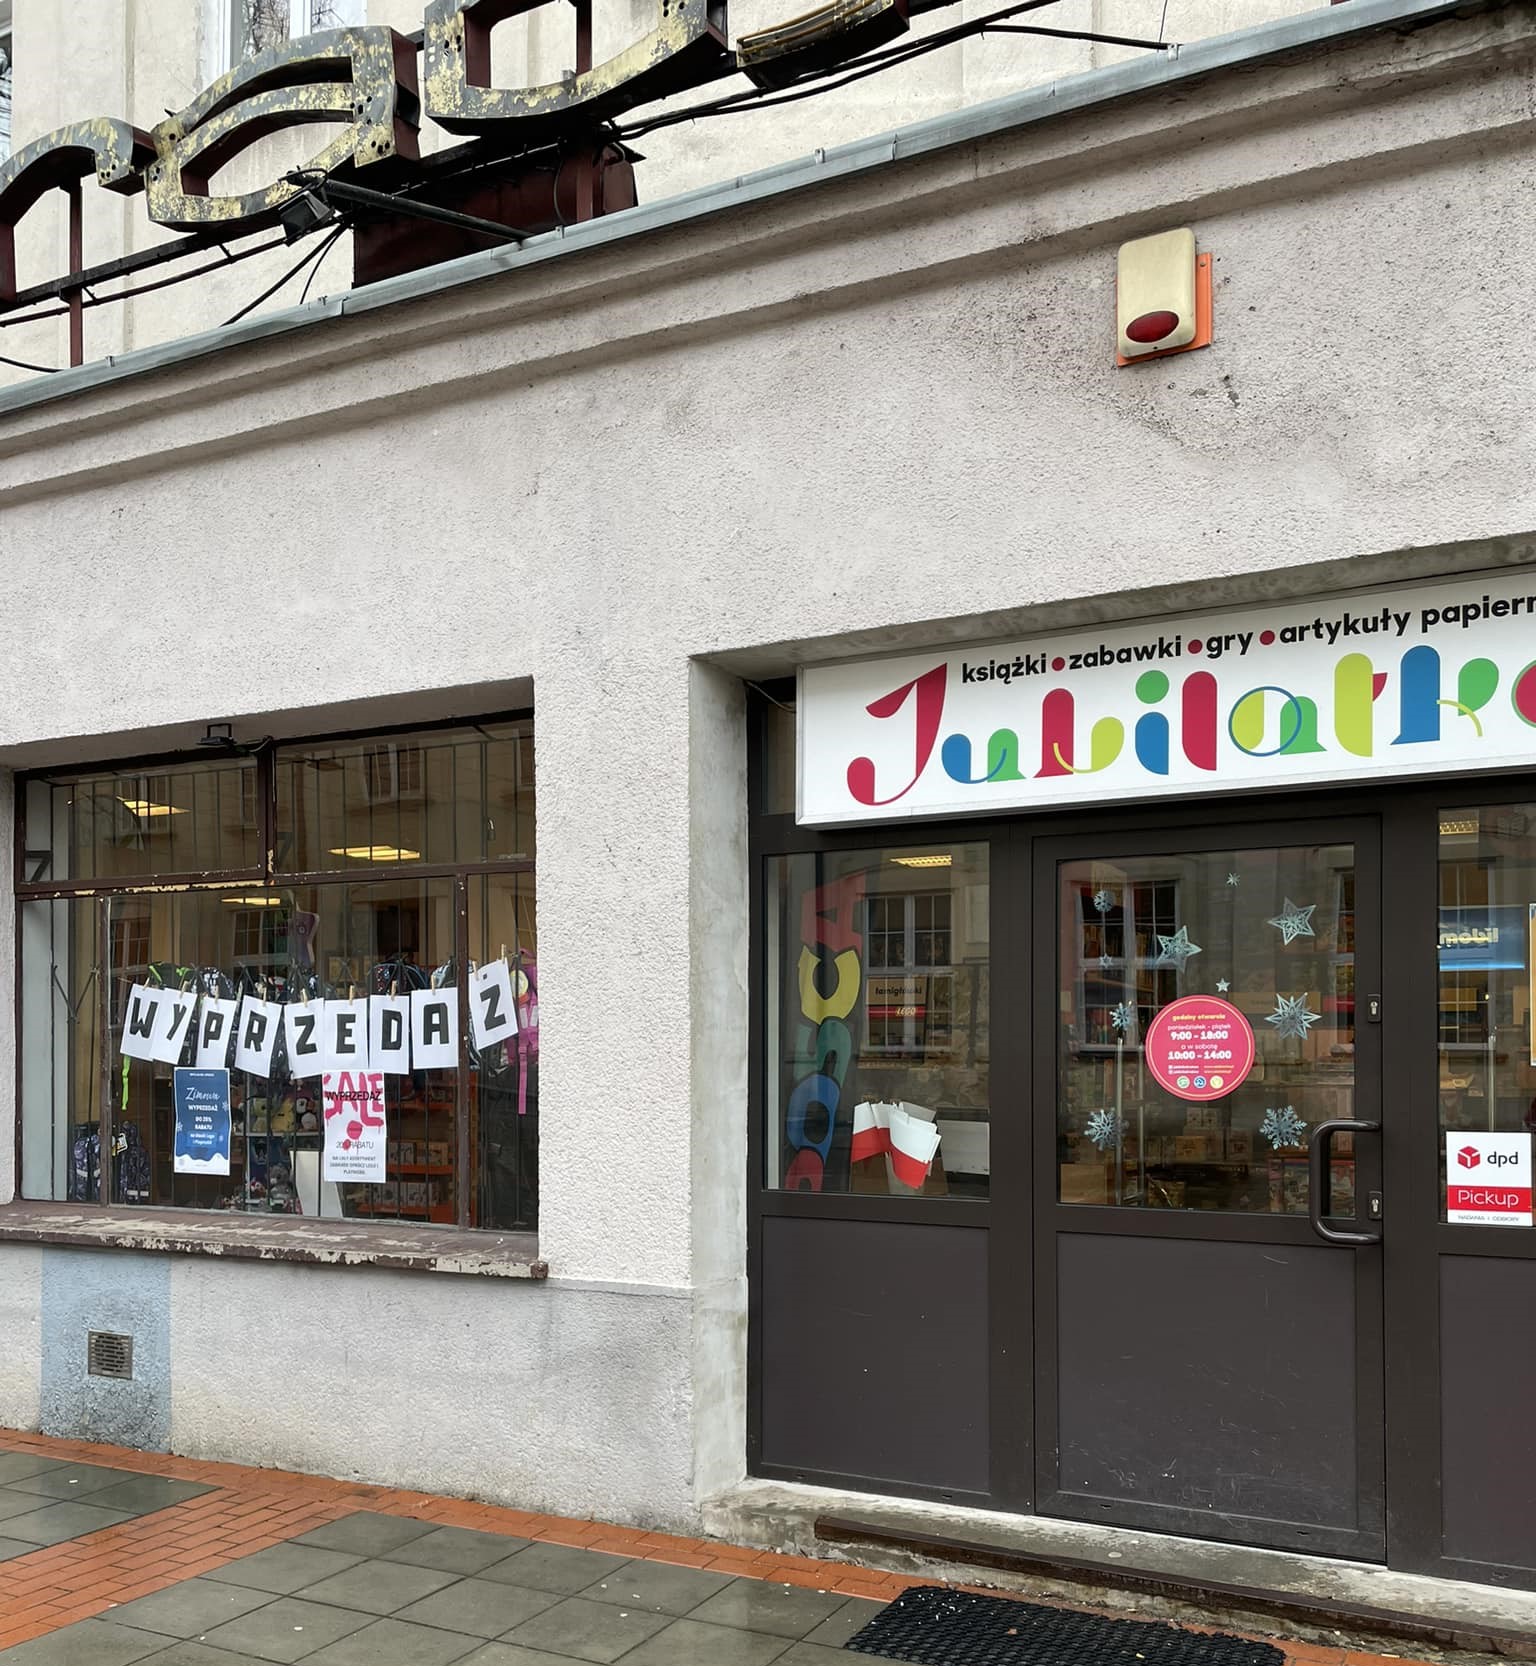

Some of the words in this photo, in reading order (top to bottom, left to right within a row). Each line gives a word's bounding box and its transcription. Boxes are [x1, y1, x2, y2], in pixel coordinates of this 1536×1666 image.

[961, 652, 1046, 685] książki
[1069, 635, 1182, 671] zabawki
[1206, 625, 1254, 659] gry
[1279, 607, 1411, 645] artykuły
[128, 972, 507, 1056] WYPRZEDAŻ
[1170, 1031, 1192, 1040] 9:00
[1200, 1030, 1229, 1040] 18:00
[1168, 1050, 1196, 1060] 10:00
[1203, 1049, 1232, 1060] 14:00
[1487, 1151, 1519, 1168] dpd
[1457, 1189, 1519, 1209] Pickup
